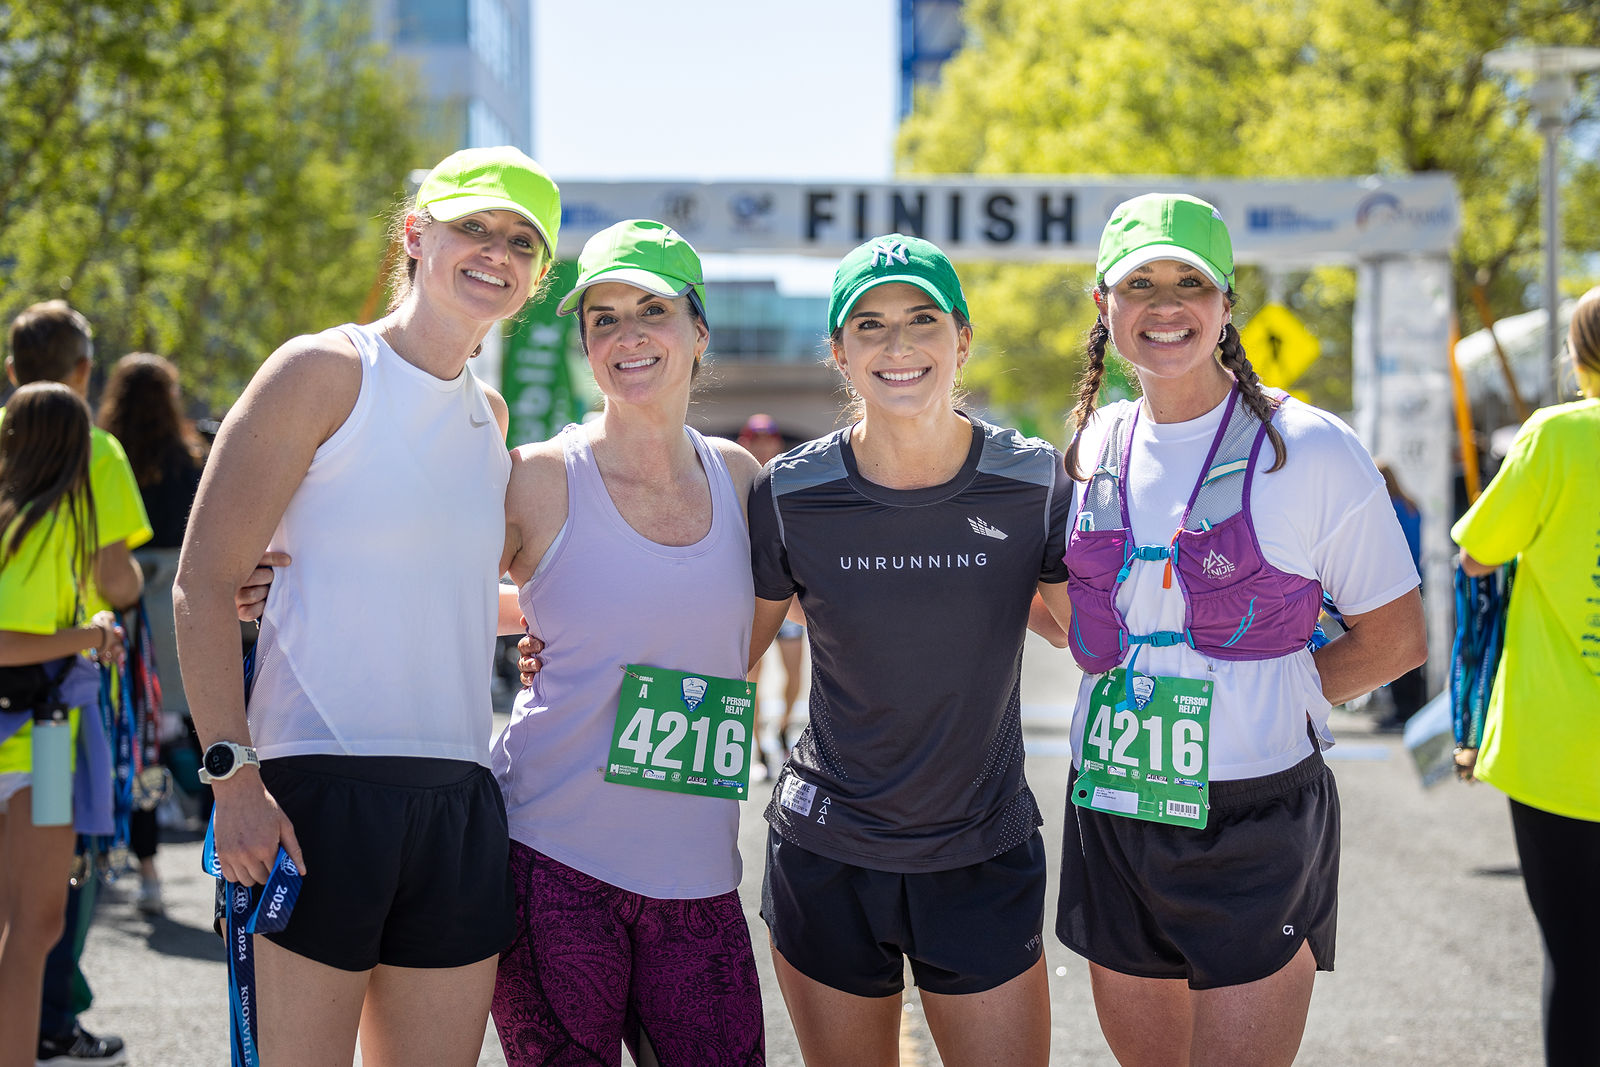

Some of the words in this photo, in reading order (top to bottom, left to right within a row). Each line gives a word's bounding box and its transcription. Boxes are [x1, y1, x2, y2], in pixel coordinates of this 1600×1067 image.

[804, 190, 1077, 243] FINISH
[871, 240, 909, 268] NY
[840, 553, 987, 570] UNRUNNING
[638, 684, 648, 699] A
[720, 695, 726, 705] 4
[726, 696, 751, 708] PERSON
[1172, 695, 1179, 704] 4
[1179, 695, 1209, 707] PERSON
[724, 705, 744, 716] RELAY
[1178, 705, 1201, 715] RELAY
[618, 707, 746, 777] 4216
[1088, 704, 1203, 776] 4216
[266, 885, 287, 919] 2024
[237, 926, 247, 961] 2024
